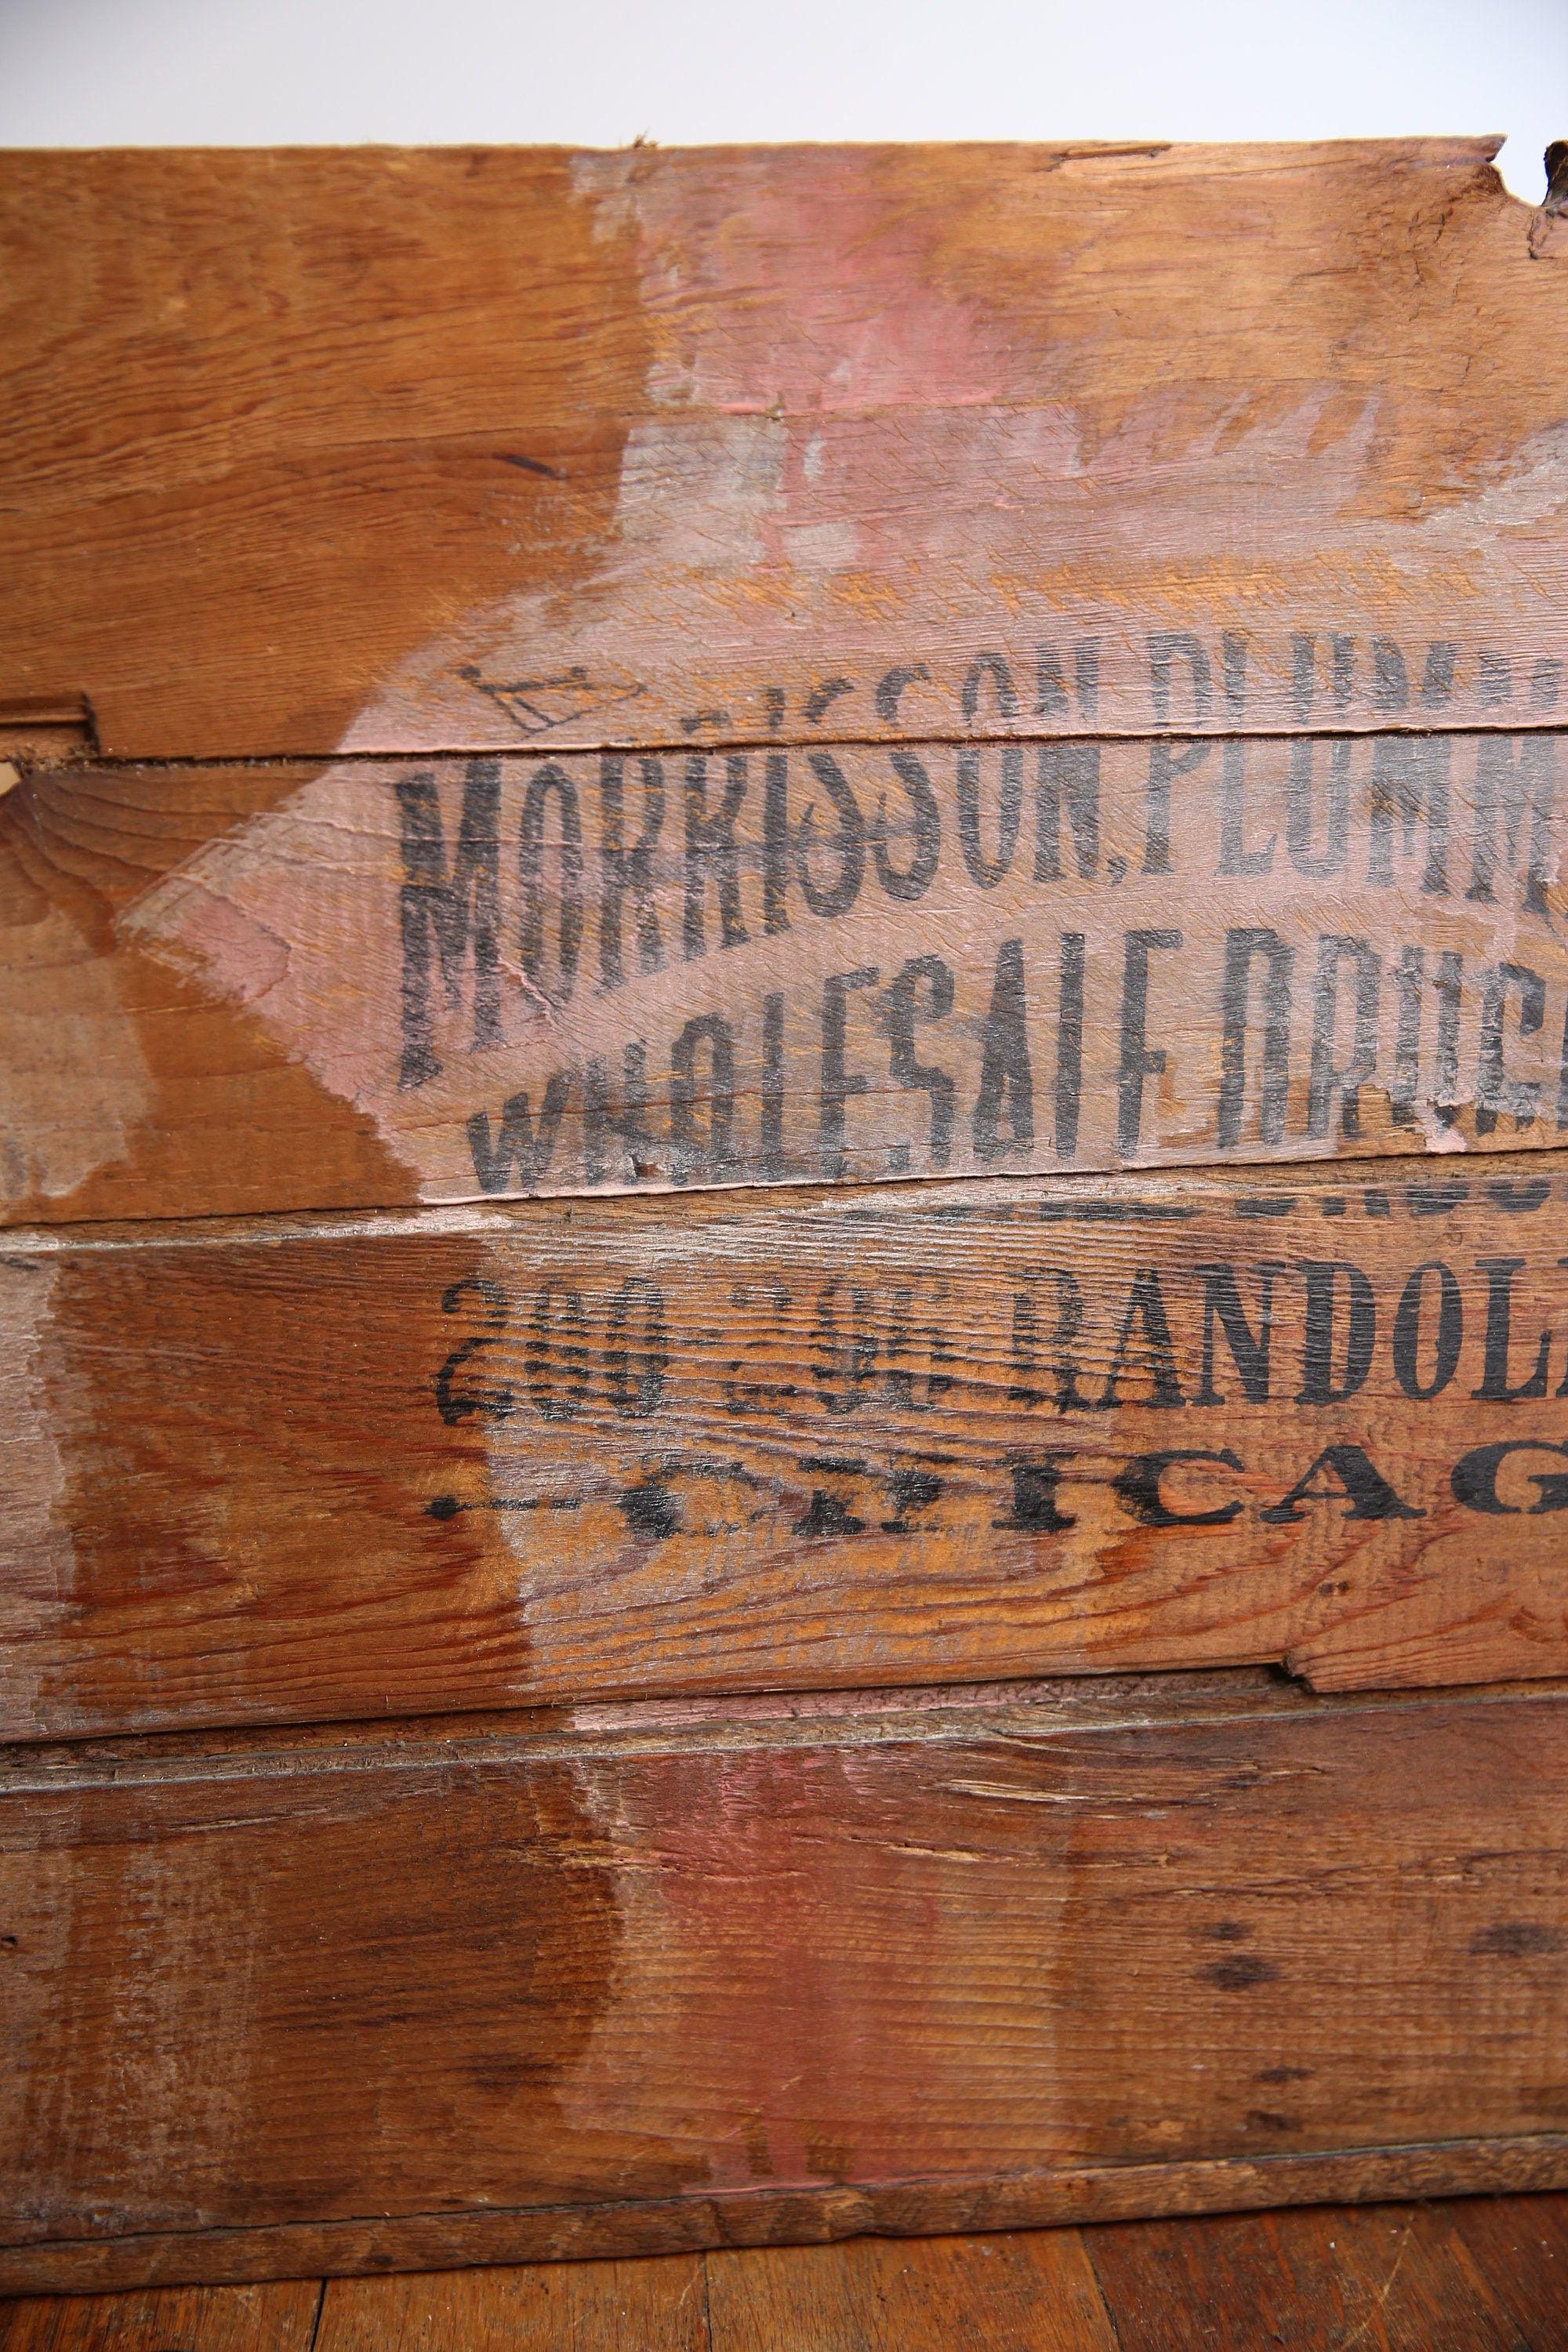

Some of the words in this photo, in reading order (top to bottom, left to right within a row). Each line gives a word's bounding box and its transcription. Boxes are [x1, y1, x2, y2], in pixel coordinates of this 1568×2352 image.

[1141, 630, 1568, 917] PLUMM
[1215, 927, 1568, 1217] DRUG
[1009, 1257, 1568, 1413] RANDOL
